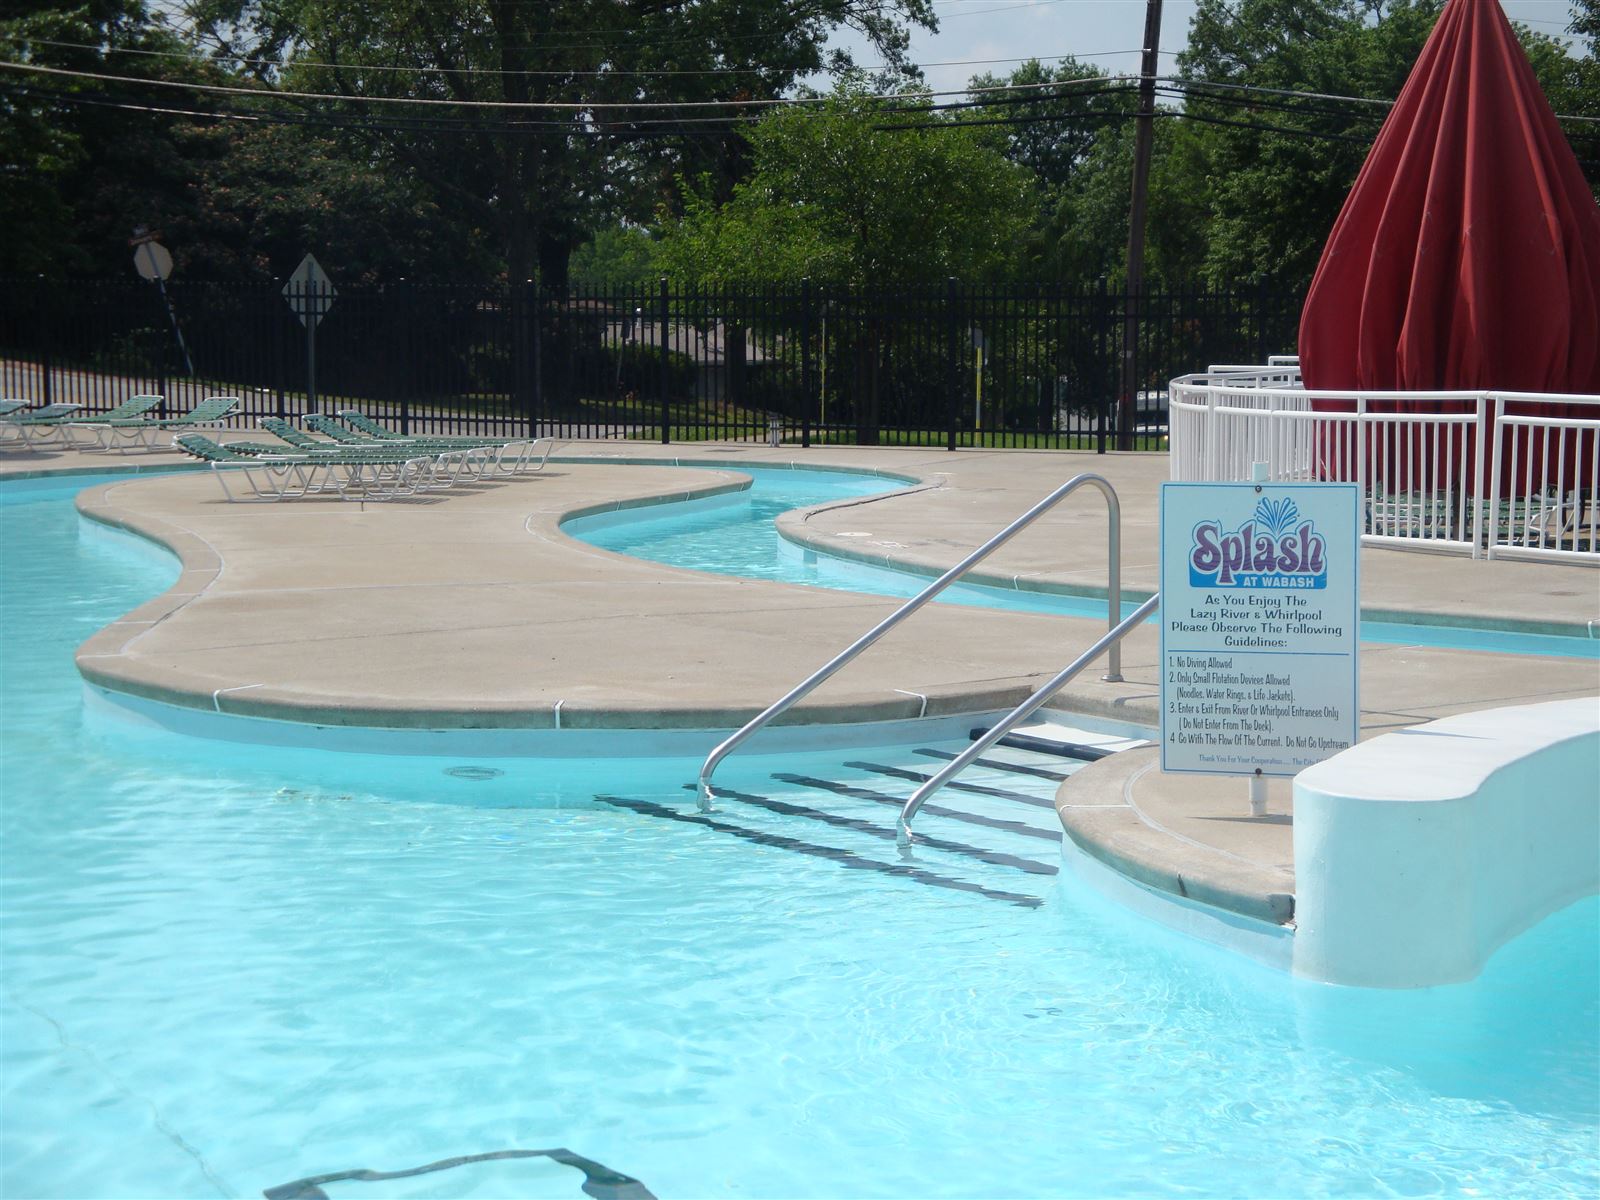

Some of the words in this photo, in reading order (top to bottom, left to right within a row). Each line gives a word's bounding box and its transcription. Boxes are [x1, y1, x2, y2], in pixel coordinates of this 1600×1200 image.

[1193, 523, 1323, 583] Splash
[1243, 576, 1258, 587] AT
[1262, 576, 1314, 588] WABASH
[1205, 594, 1220, 605] As
[1223, 594, 1245, 605] You
[1248, 595, 1281, 608] Enjoy
[1285, 595, 1307, 606] The
[1190, 608, 1217, 621] Lazy
[1220, 608, 1250, 619] River
[1264, 609, 1322, 622] Whirlpool
[1171, 621, 1208, 632] Please
[1211, 621, 1257, 633] Observe
[1260, 622, 1283, 634] The
[1286, 623, 1342, 637] Following
[1224, 635, 1288, 647] Guidelines:
[1169, 656, 1175, 668] 1.
[1177, 656, 1186, 668] No
[1186, 656, 1207, 671] Diving
[1208, 657, 1233, 669] Allowed
[1169, 671, 1176, 683] 2.
[1177, 672, 1192, 686] Only
[1192, 672, 1211, 684] Small
[1212, 672, 1239, 684] Flotation
[1240, 673, 1264, 685] Devices
[1265, 674, 1291, 686] Allowed
[1206, 688, 1225, 699] Water
[1253, 688, 1266, 700] Life
[1267, 689, 1296, 704] Jackets).
[1169, 702, 1177, 714] 3.
[1178, 703, 1194, 714] Enter
[1201, 703, 1214, 714] Exit
[1214, 703, 1232, 715] From
[1232, 704, 1249, 716] River
[1250, 704, 1258, 716] Or
[1259, 704, 1291, 719] Whirlpool
[1324, 706, 1339, 721] Only
[1183, 717, 1192, 729] Do
[1193, 717, 1204, 729] Not
[1205, 718, 1221, 729] Enter
[1222, 718, 1239, 730] From
[1241, 719, 1253, 731] The
[1254, 720, 1274, 734] Deck).
[1178, 732, 1187, 744] Go
[1188, 733, 1204, 744] With
[1205, 733, 1217, 746] The
[1218, 734, 1233, 745] Flow
[1234, 734, 1243, 746] Of
[1244, 734, 1256, 746] The
[1256, 735, 1283, 747] Current.
[1286, 736, 1295, 747] Do
[1296, 736, 1307, 748] Not
[1308, 736, 1317, 749] Go
[1199, 755, 1215, 763] Thank
[1237, 756, 1250, 764] Your
[1292, 758, 1303, 766] The
